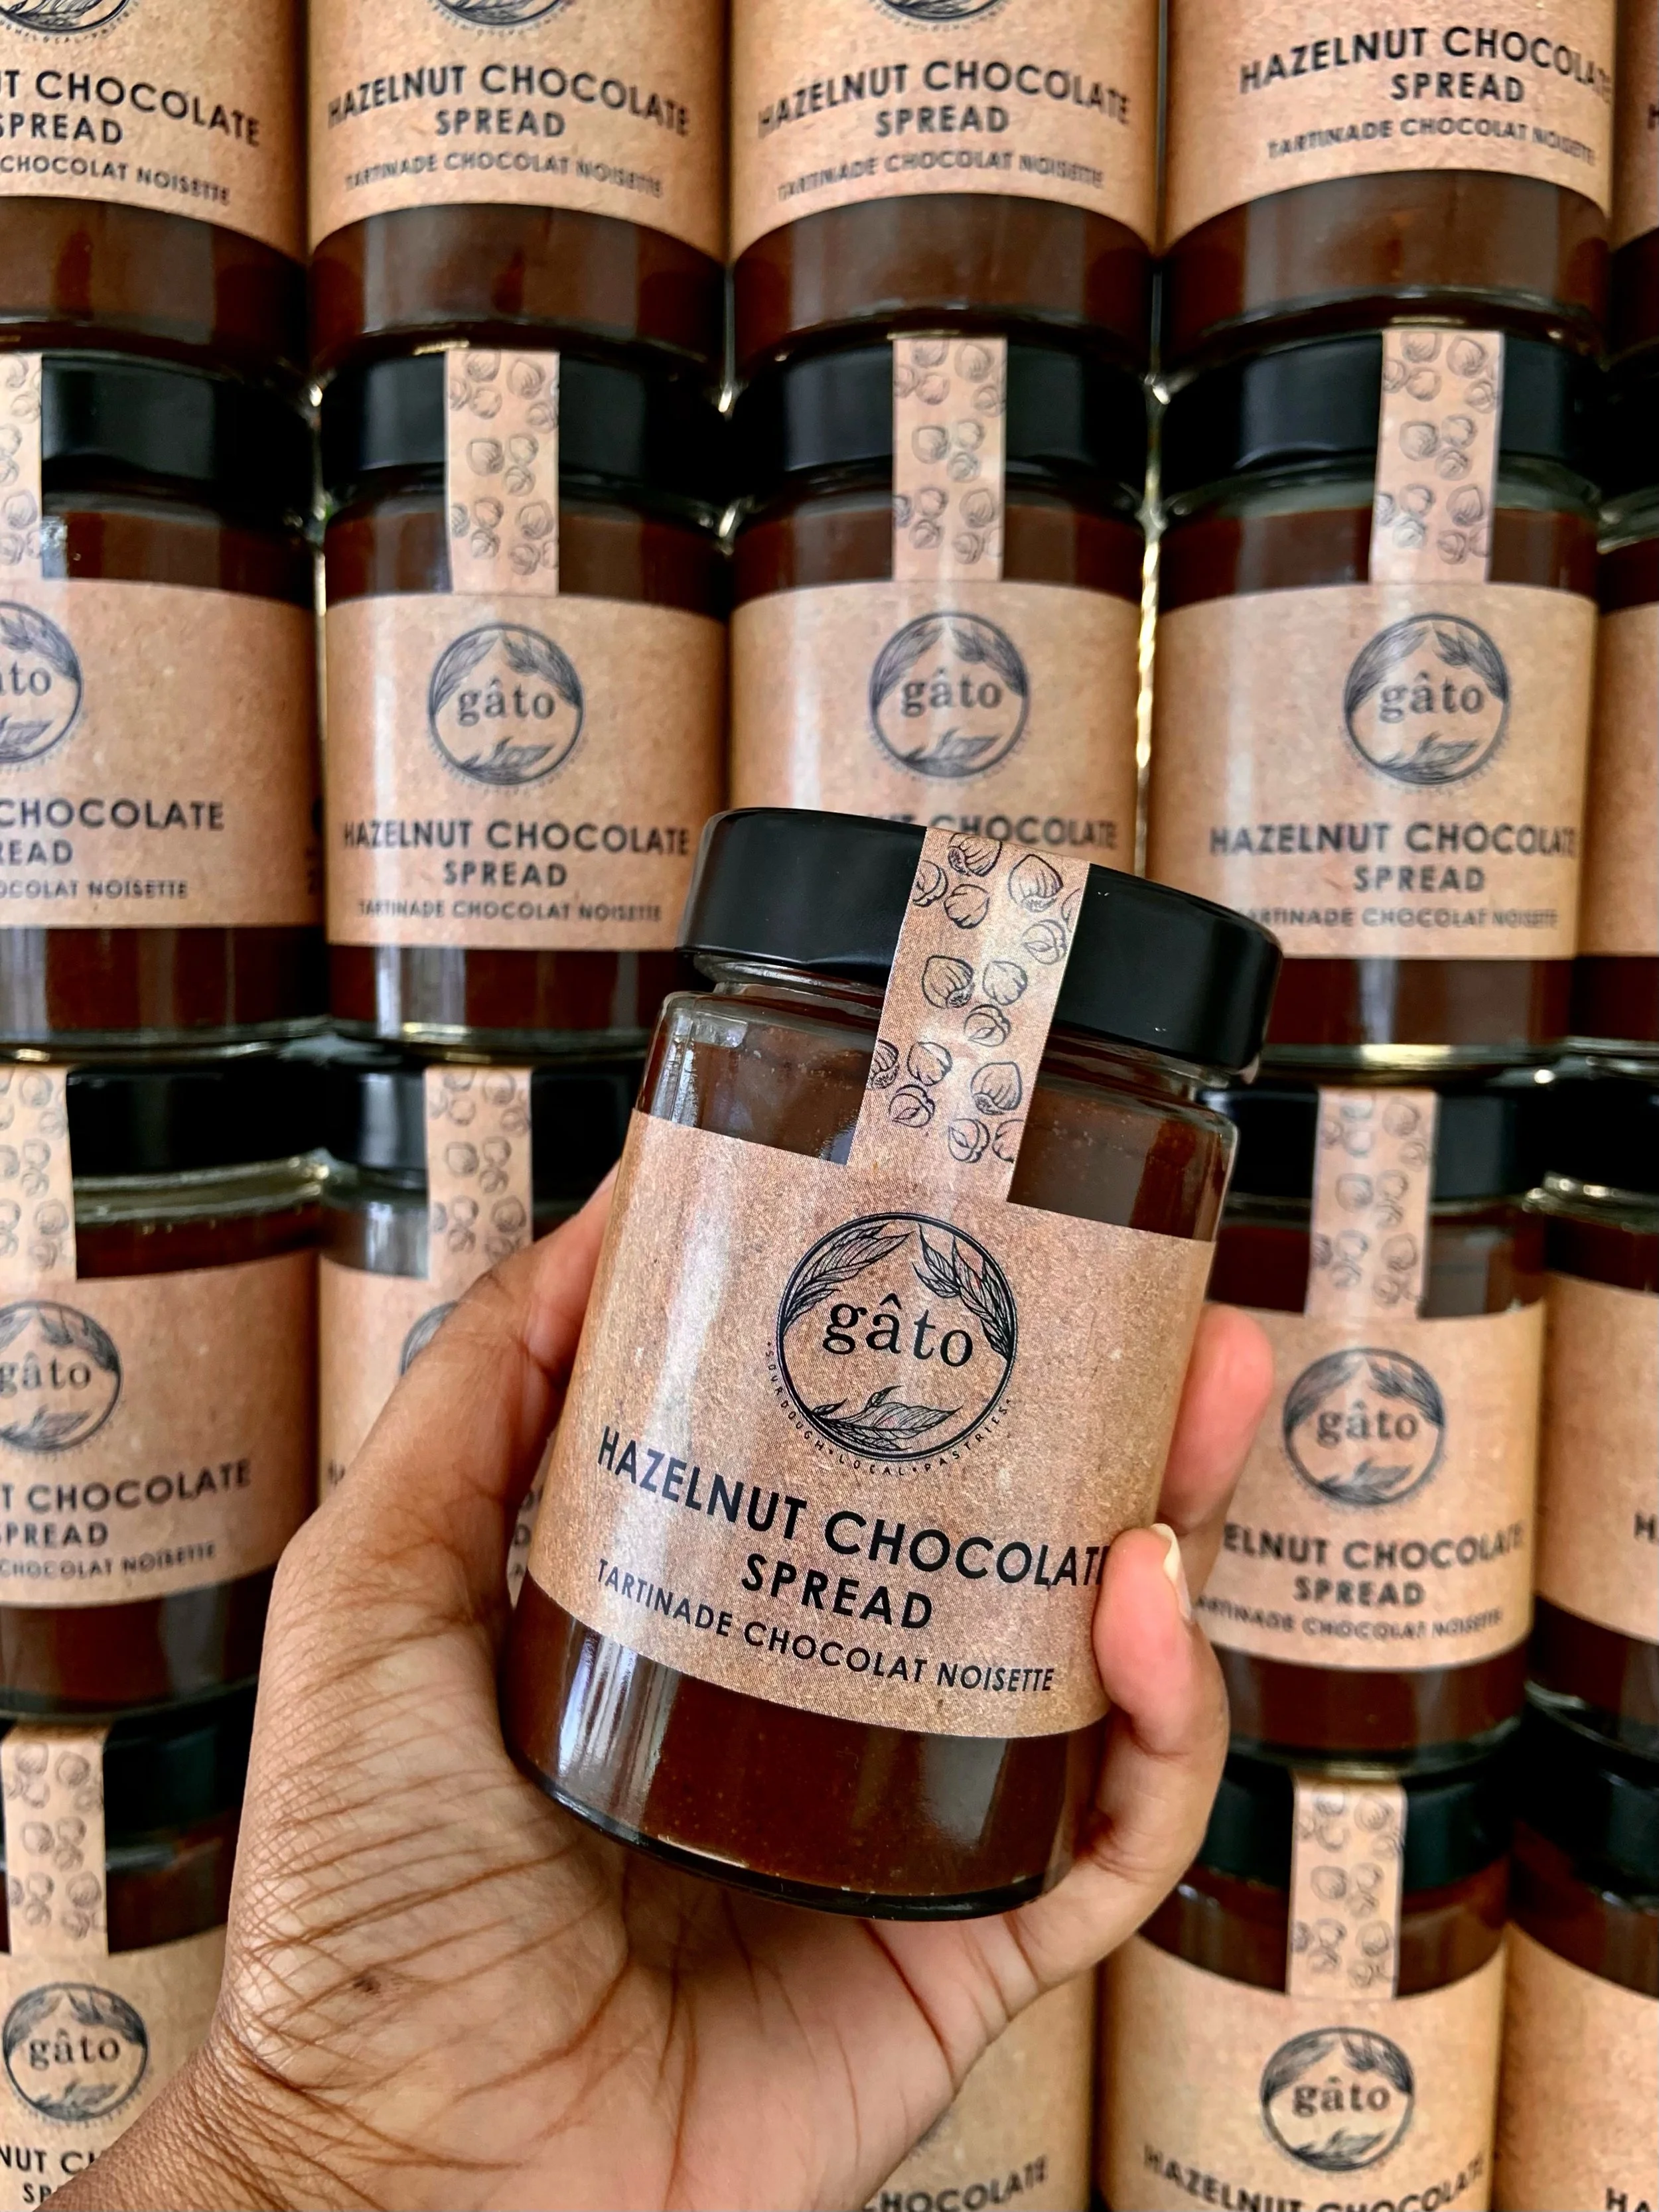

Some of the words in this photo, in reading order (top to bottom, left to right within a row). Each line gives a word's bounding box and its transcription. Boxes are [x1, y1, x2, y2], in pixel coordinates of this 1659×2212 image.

[1239, 27, 1427, 95] HAZELNUT
[327, 65, 467, 129] HAZELNUT
[481, 64, 690, 137] CHOCOLATE
[757, 63, 907, 139] HAZELNUT
[922, 60, 1130, 126] CHOCOLATE
[1390, 71, 1525, 104] SPREAD
[36, 70, 261, 147] CHOCOLATE
[435, 109, 566, 138] SPREAD
[875, 105, 1009, 137] SPREAD
[0, 111, 123, 145] PREAD
[1400, 117, 1527, 142] CHOCOLAT
[444, 151, 569, 173] CHOCOLAT
[884, 149, 1013, 173] CHOCOLAT
[0, 155, 129, 182] CHOCOLAT
[137, 167, 230, 206] NOISETTE
[457, 675, 556, 726] gâto
[901, 667, 1003, 718] gâto
[1379, 670, 1484, 723] gâto
[343, 819, 473, 850] HAZELNUT
[486, 820, 690, 856] CHOCOLATE
[1210, 822, 1391, 857] HAZELNUT
[88, 879, 188, 900] NOISETTE
[443, 860, 568, 888] SPREAD
[1353, 863, 1486, 893] SPREAD
[452, 900, 570, 921] CHOCOLAT
[1362, 907, 1487, 928] CHOCOLAT
[822, 1292, 974, 1367] gâto
[1316, 1402, 1419, 1446] gâto
[839, 1453, 906, 1476] LOCAL
[28, 1458, 252, 1513] CHOCOLATE
[597, 1426, 808, 1541] HAZELNUT
[0, 1521, 109, 1549] PREAD
[1224, 1521, 1329, 1566] ELNUT
[121, 1540, 217, 1574] NOISETTE
[741, 1553, 933, 1631] SPREAD
[1293, 1574, 1425, 1608] SPREAD
[597, 1558, 733, 1637] TARTINADE
[744, 1621, 928, 1684] CHOCOLAT
[937, 1663, 1055, 1692] NOISETTE
[29, 2028, 120, 2071] gâto
[1291, 2076, 1391, 2118] gâto
